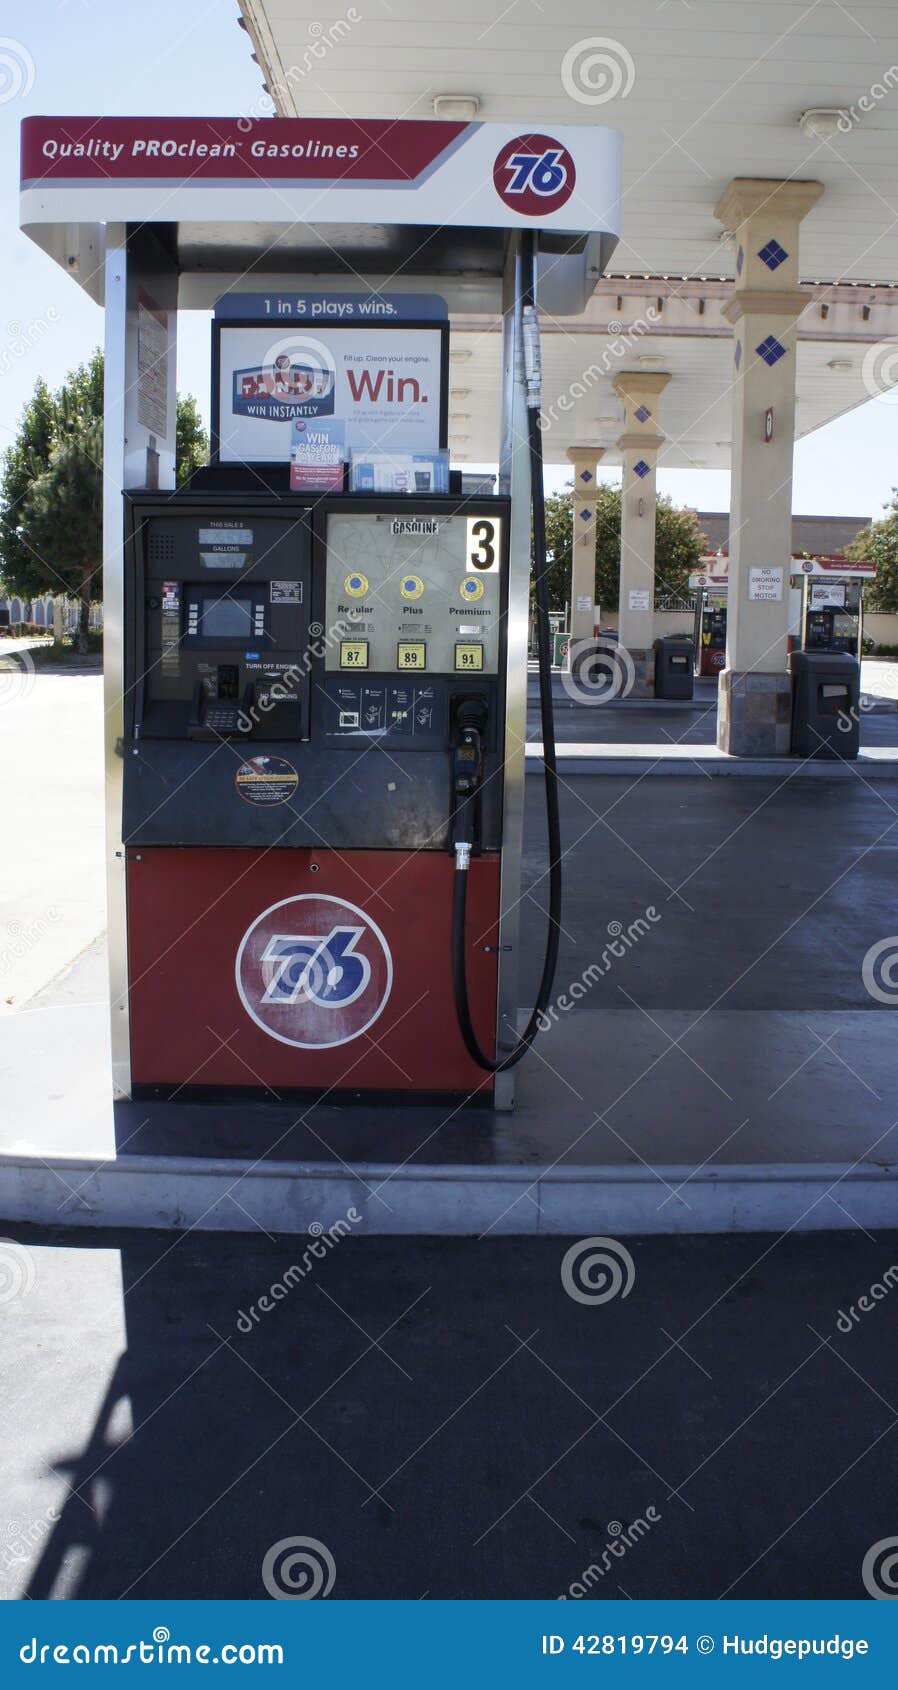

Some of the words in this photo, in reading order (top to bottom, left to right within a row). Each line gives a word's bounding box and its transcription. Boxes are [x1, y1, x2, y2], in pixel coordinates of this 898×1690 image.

[42, 138, 124, 161] Quality
[250, 140, 360, 158] Gasolines
[504, 148, 568, 197] 76
[264, 299, 271, 313] 1
[277, 299, 292, 313] in
[296, 299, 307, 313] 5
[311, 299, 354, 317] plays
[358, 300, 398, 315] wins.
[346, 369, 428, 402] Win.
[247, 405, 266, 416] WIN
[269, 405, 318, 418] INSTANTLY
[306, 432, 329, 444] WIN
[298, 443, 317, 453] GAS
[319, 444, 337, 453] FOR
[392, 522, 437, 534] GASOLINE
[470, 520, 495, 570] 3
[402, 606, 424, 615] Plus
[449, 607, 491, 616] Premium
[347, 651, 360, 662] 87
[404, 652, 418, 663] 89
[462, 654, 475, 664] 91
[259, 925, 372, 1009] 76
